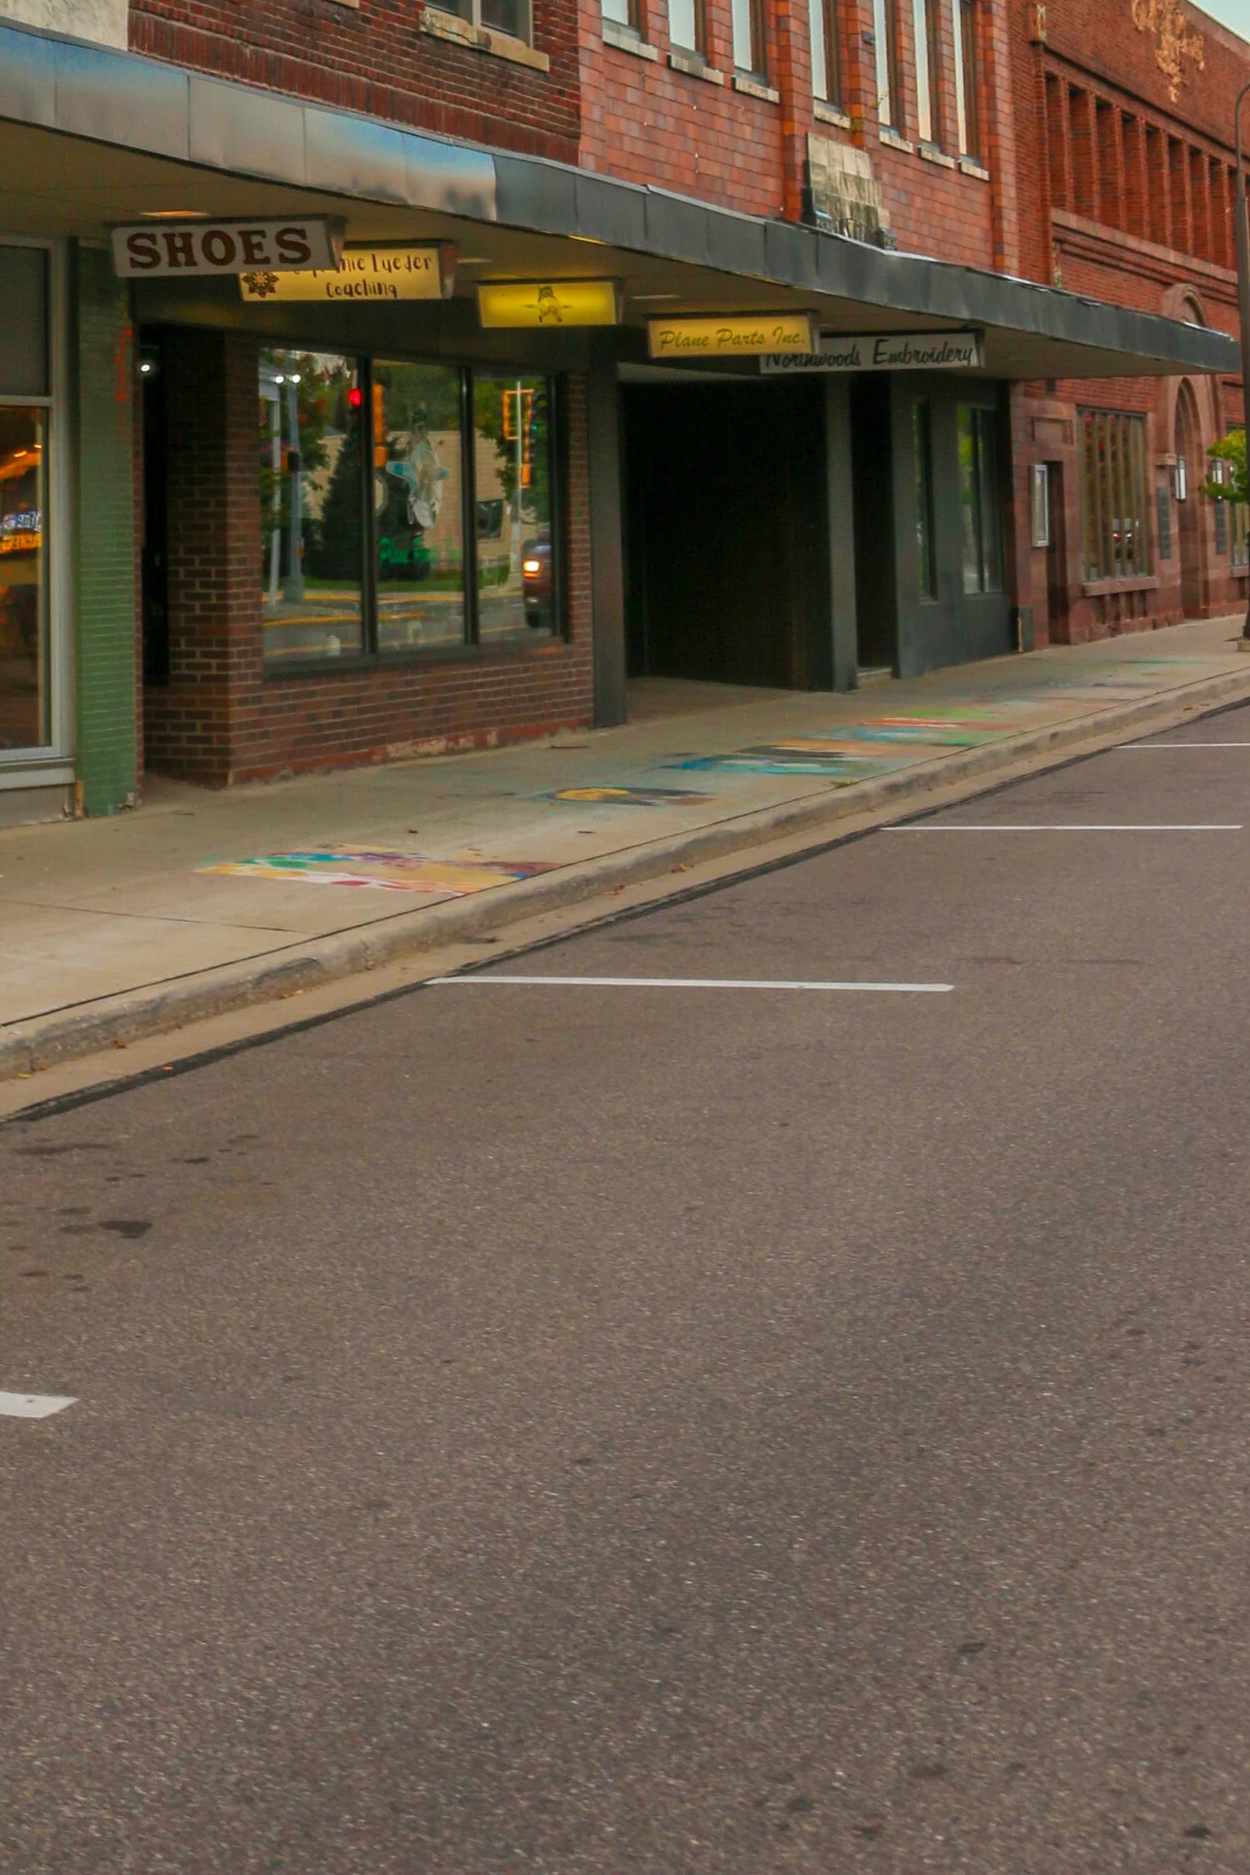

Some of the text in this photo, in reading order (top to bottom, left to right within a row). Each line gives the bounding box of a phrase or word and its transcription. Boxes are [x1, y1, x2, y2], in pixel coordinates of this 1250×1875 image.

[126, 228, 312, 269] SHOES
[326, 278, 398, 299] Coaching
[659, 325, 806, 350] Plane Parts Inc.
[872, 338, 974, 367] Embroidery
